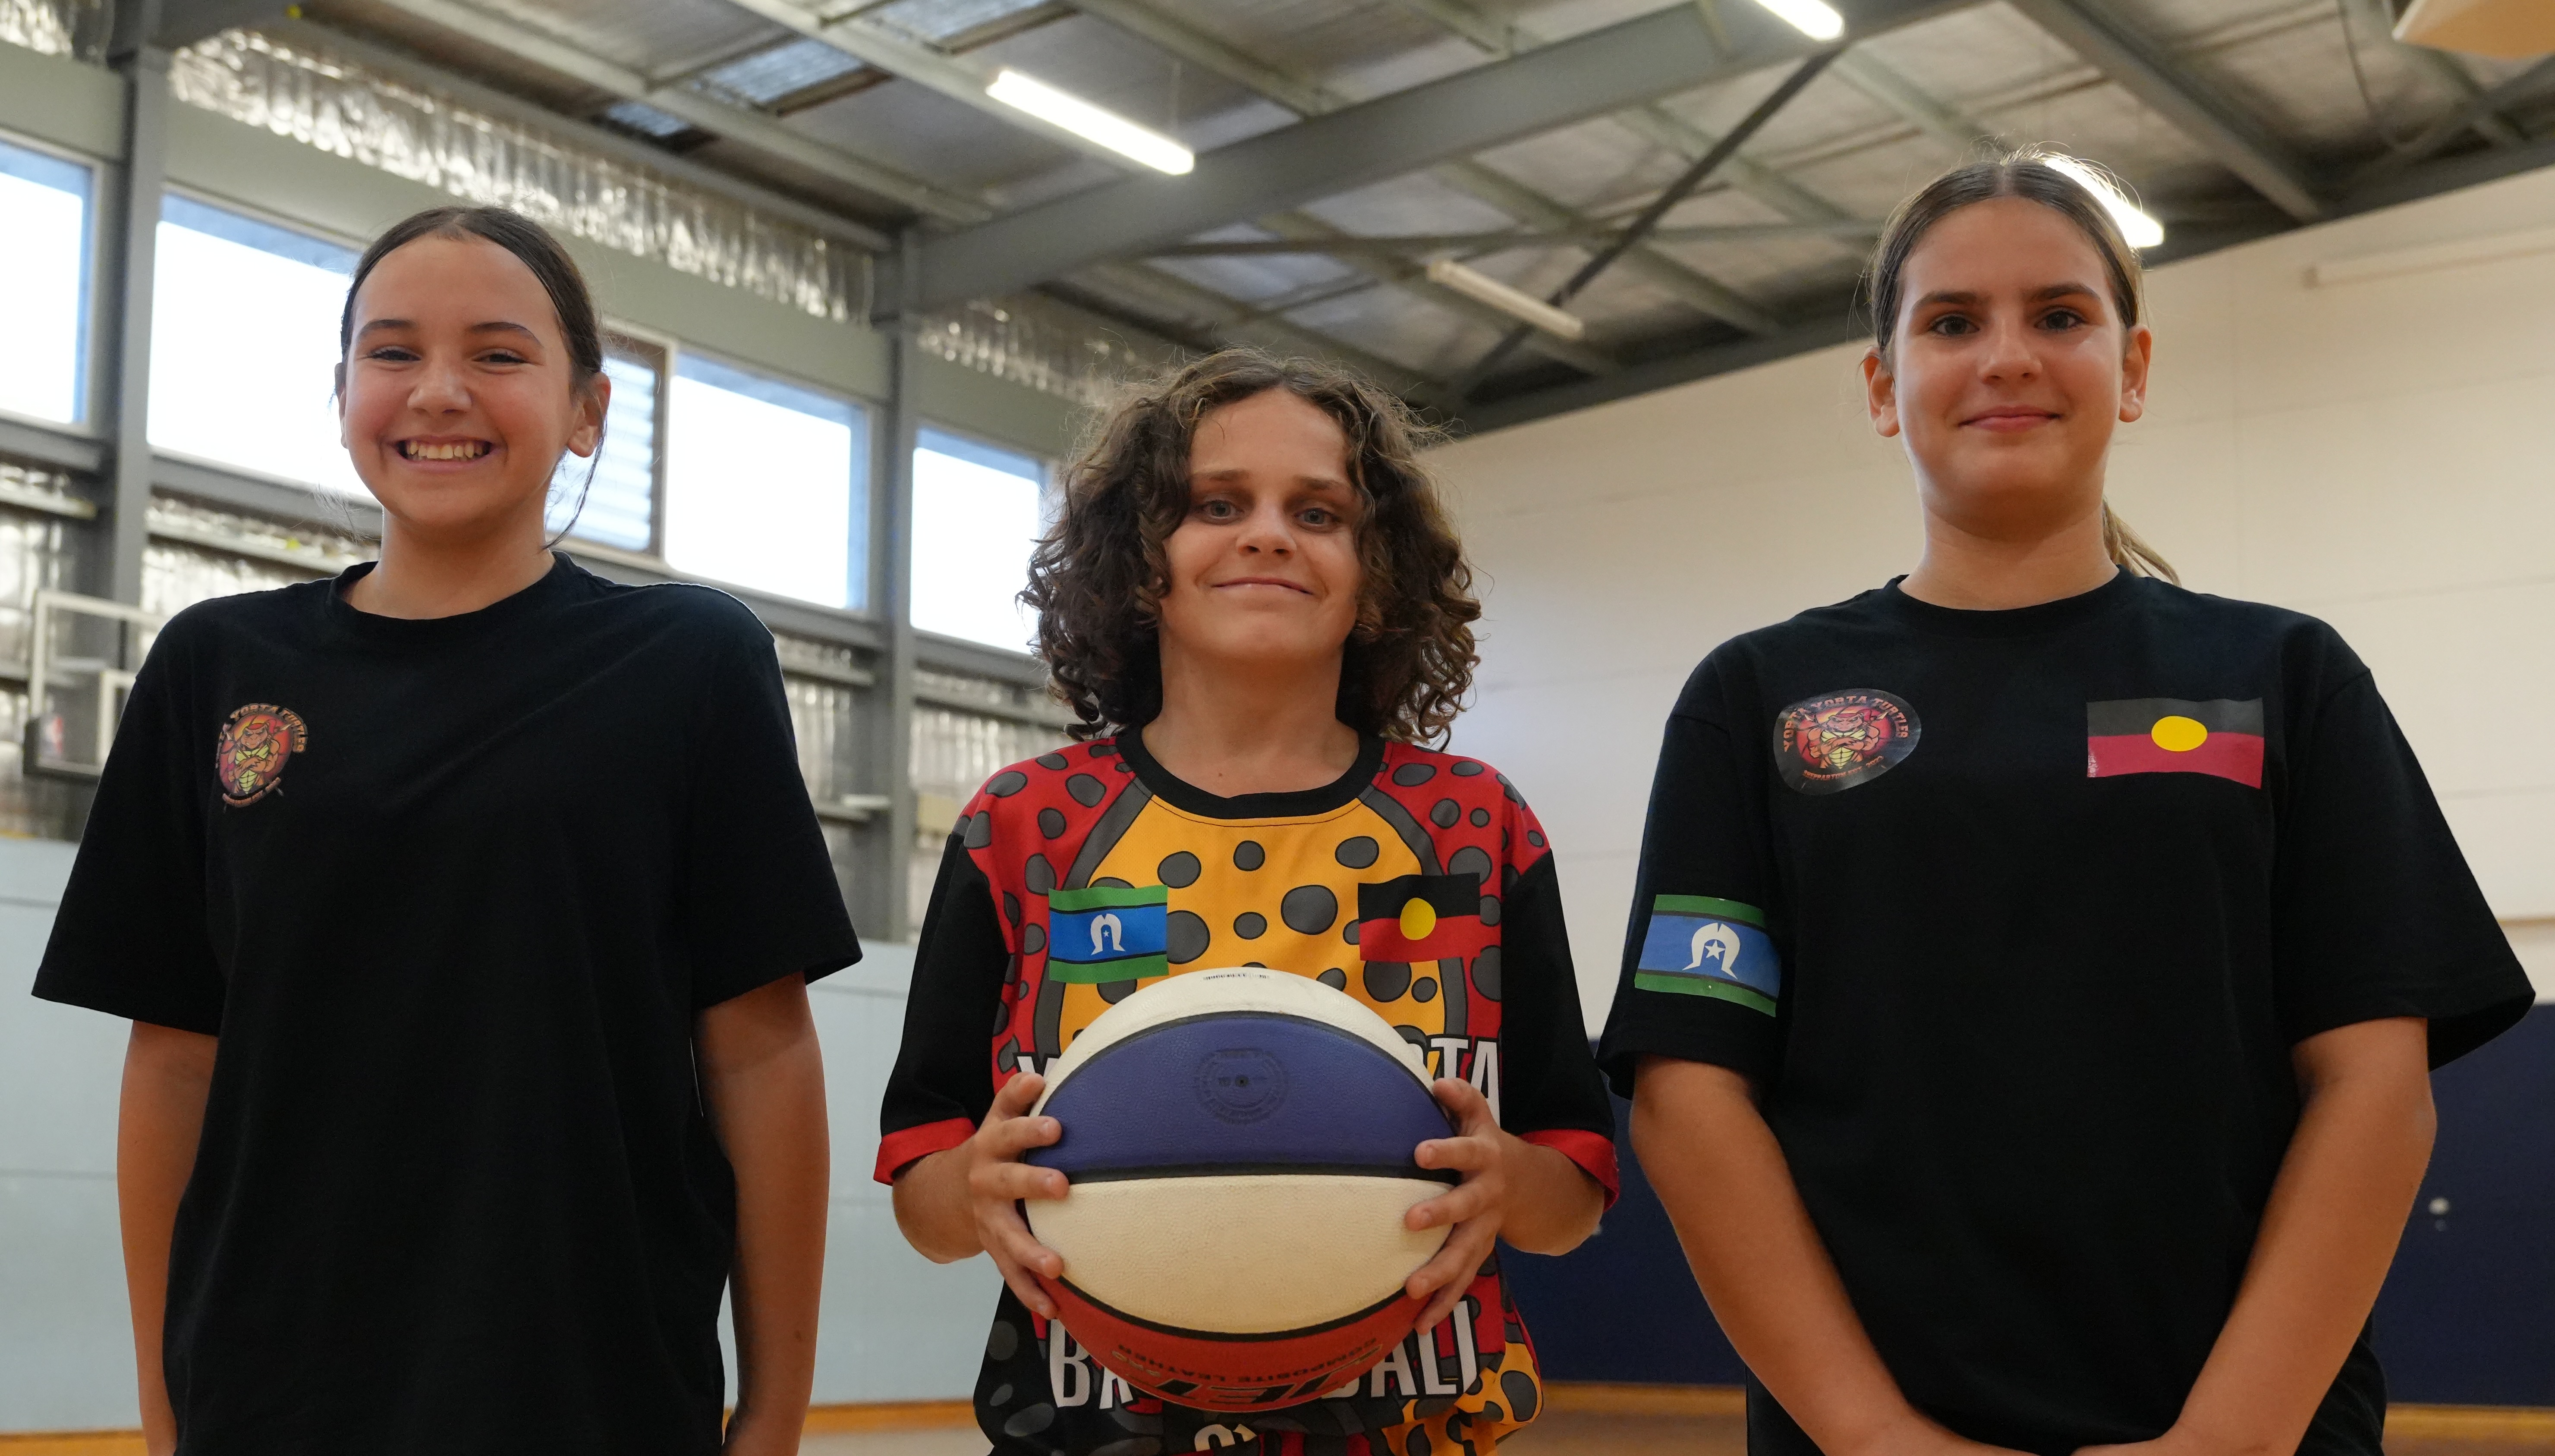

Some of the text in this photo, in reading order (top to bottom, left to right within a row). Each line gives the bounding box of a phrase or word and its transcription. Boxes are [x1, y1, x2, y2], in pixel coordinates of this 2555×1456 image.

[1811, 695, 1867, 708] YORTA
[1872, 698, 1909, 738] TURTLES
[1118, 1338, 1376, 1383] COMPOSITE LEATHER
